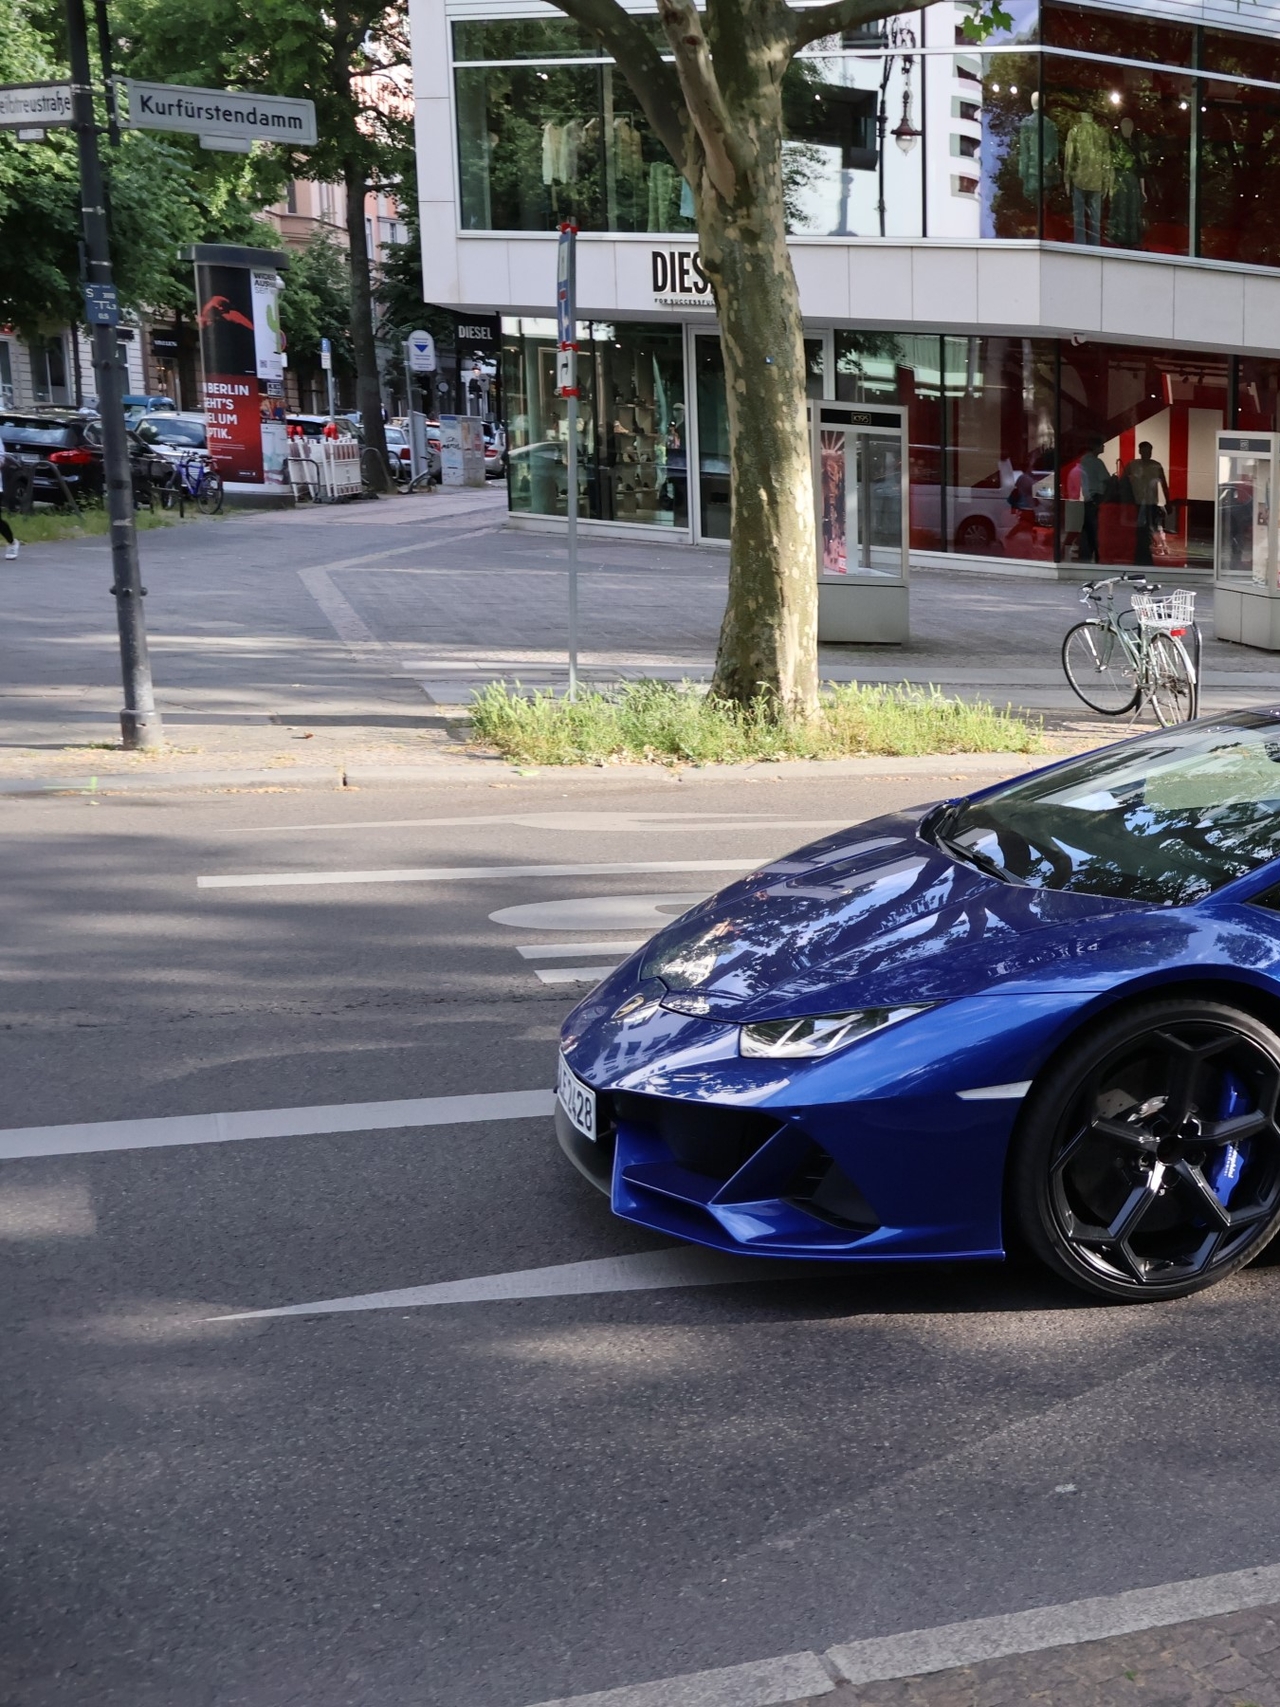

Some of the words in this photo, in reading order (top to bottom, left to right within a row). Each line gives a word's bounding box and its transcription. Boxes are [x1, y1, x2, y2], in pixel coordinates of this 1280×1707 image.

[0, 91, 71, 115] eibtreustraße
[140, 95, 303, 130] Kurfürstendamm
[652, 250, 712, 294] DIES
[458, 325, 493, 340] DIESEL
[204, 397, 235, 410] EHT'S
[206, 427, 232, 440] PTIK.
